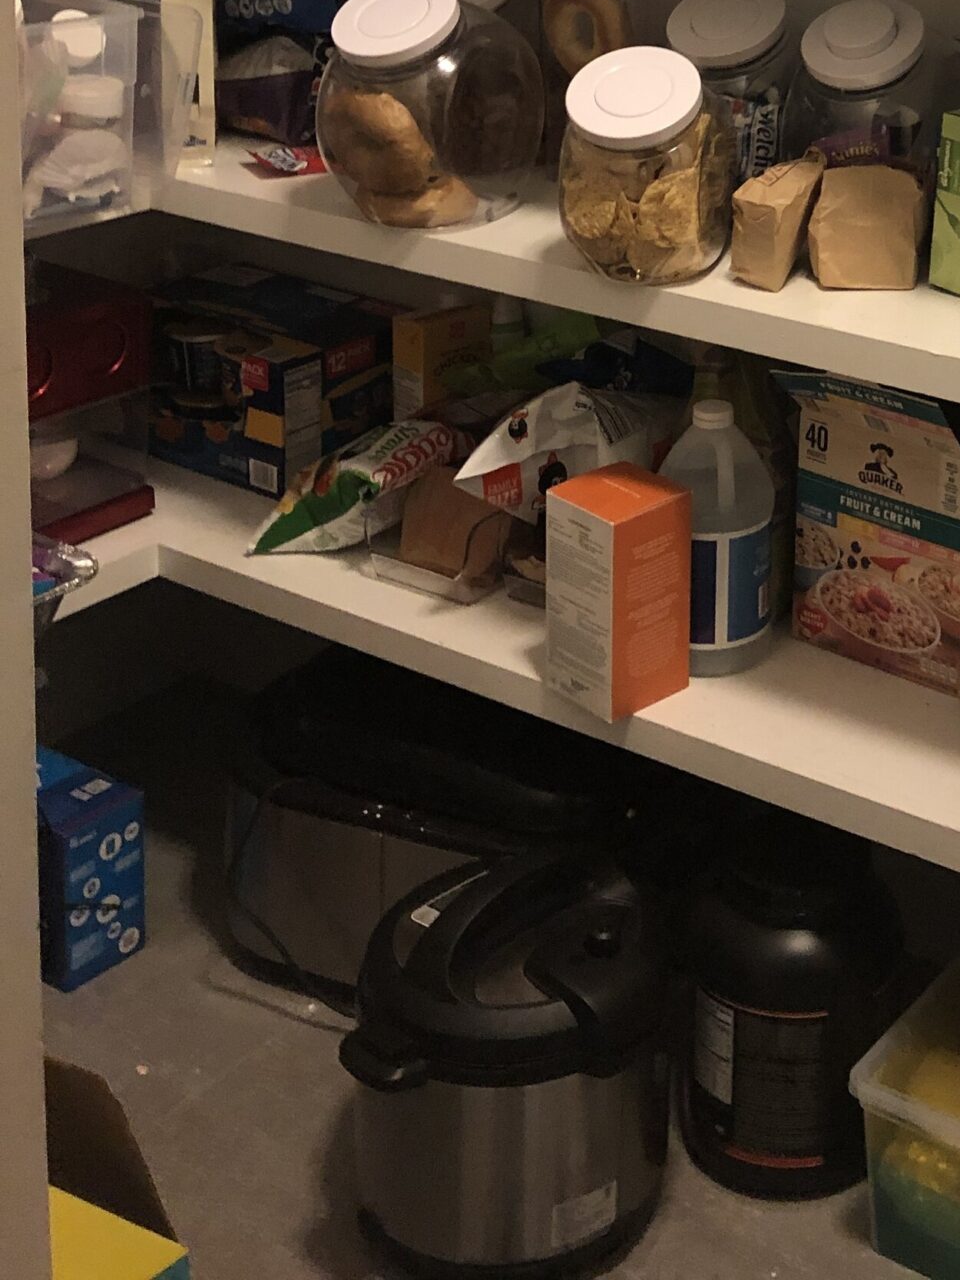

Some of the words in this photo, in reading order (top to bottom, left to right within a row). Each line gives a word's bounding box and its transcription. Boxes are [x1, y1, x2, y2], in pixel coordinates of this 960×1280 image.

[805, 423, 829, 452] 40
[487, 477, 519, 494] FAMILY
[858, 470, 904, 494] QUAKER
[839, 494, 872, 517] FRUIT
[873, 506, 882, 518] &
[883, 509, 921, 530] CREAM
